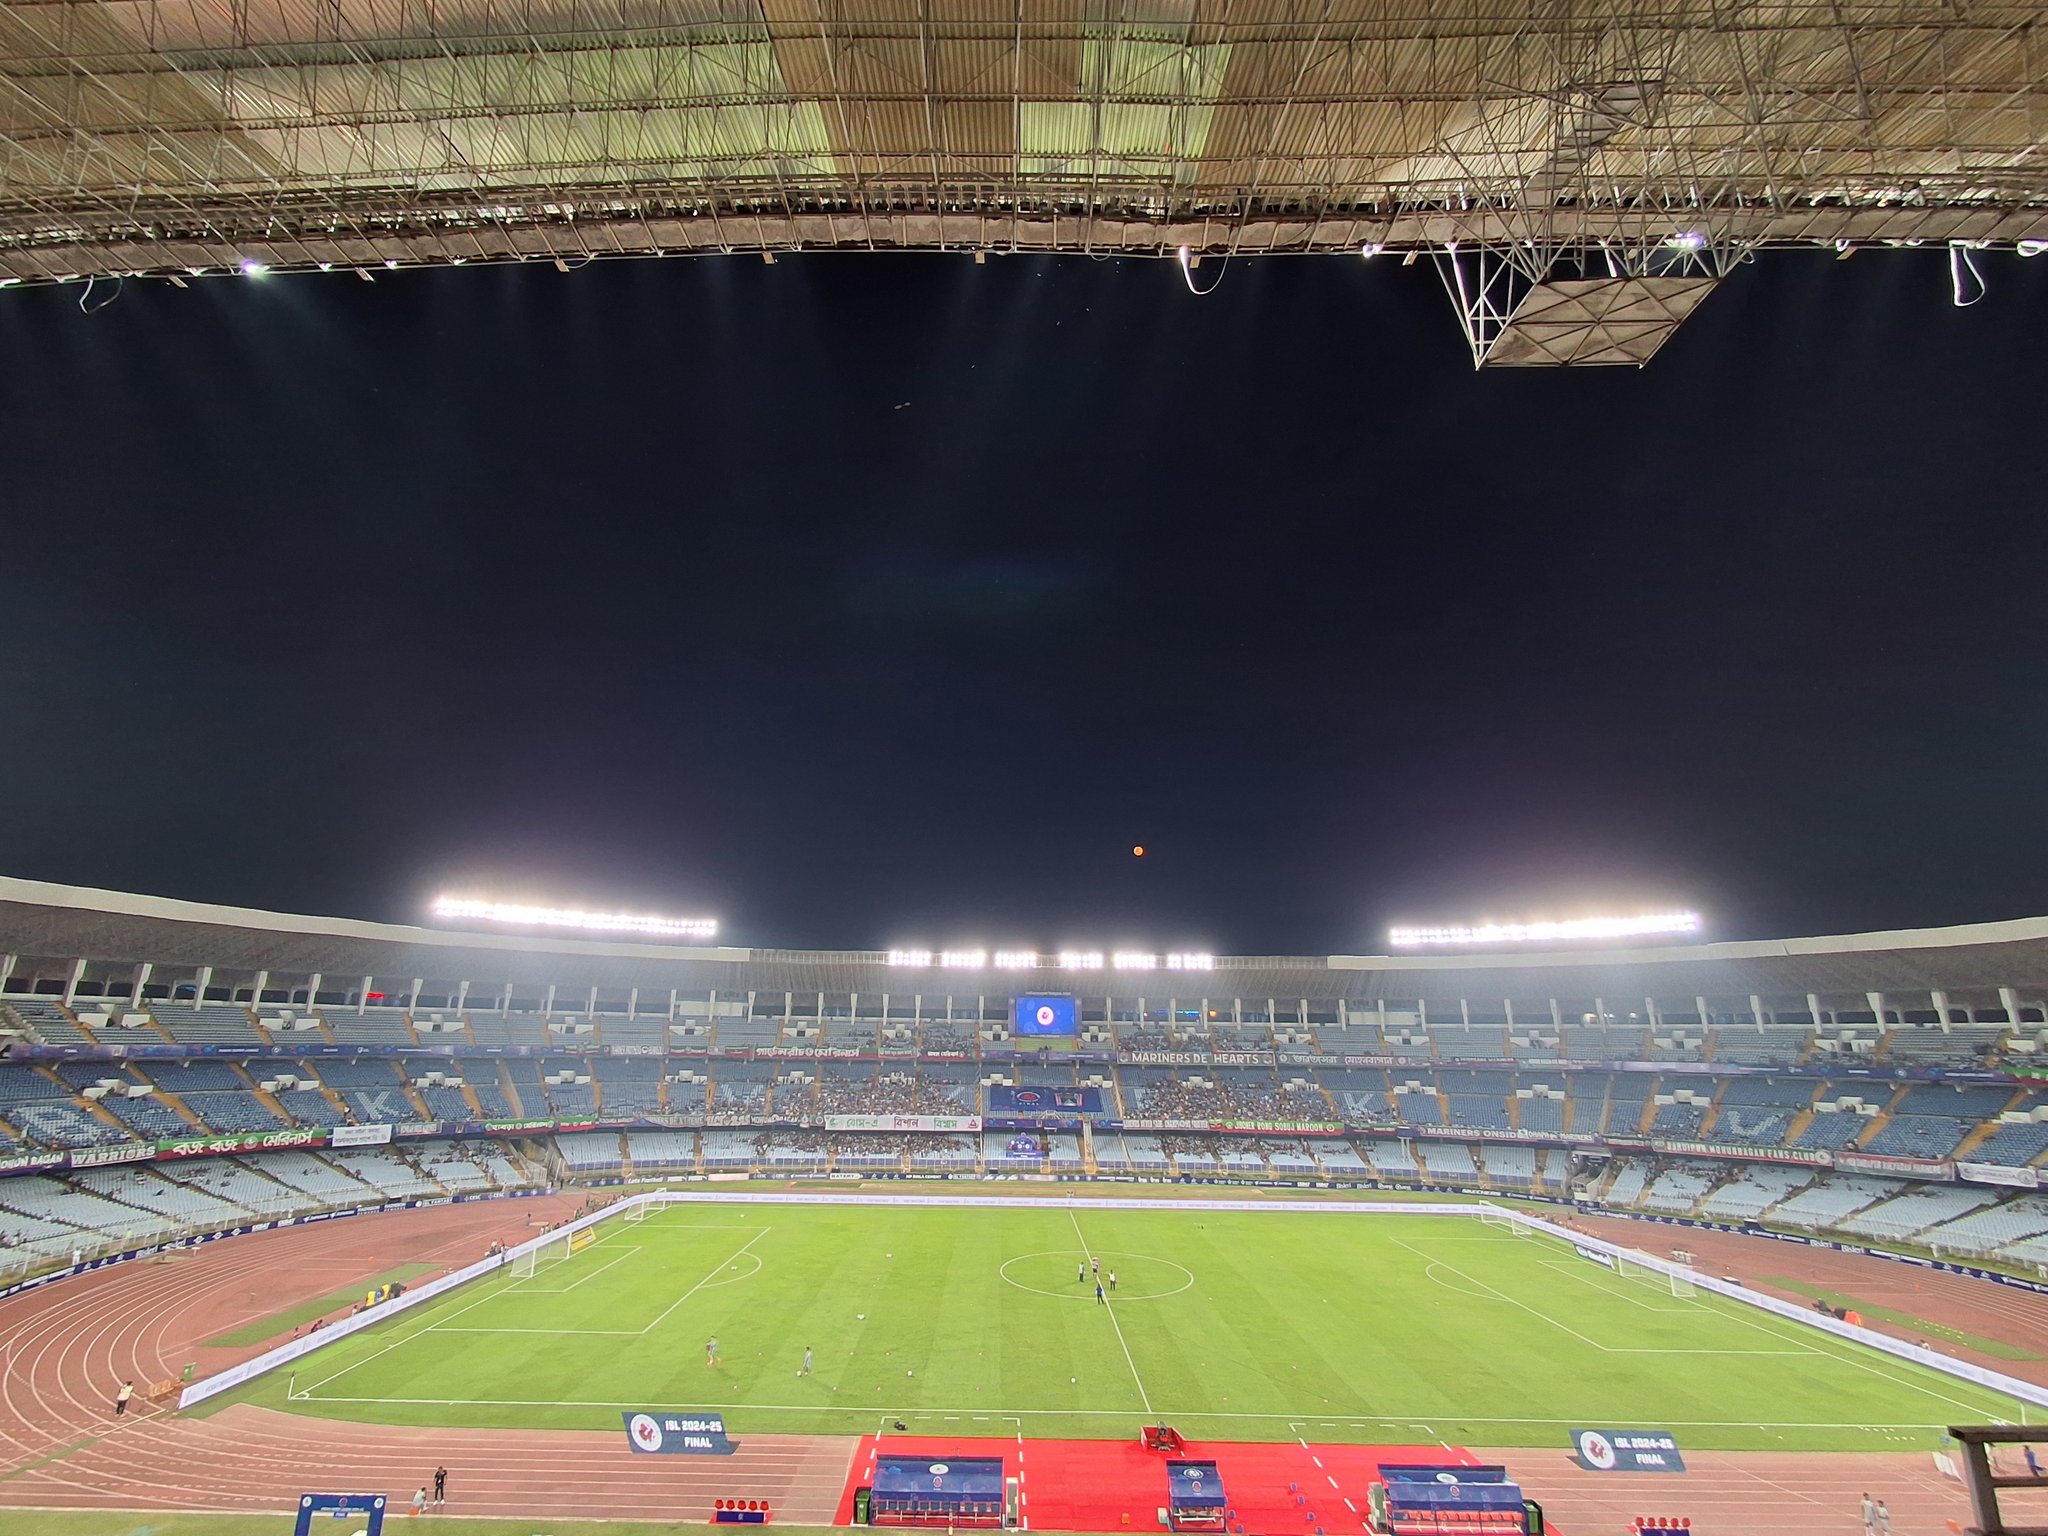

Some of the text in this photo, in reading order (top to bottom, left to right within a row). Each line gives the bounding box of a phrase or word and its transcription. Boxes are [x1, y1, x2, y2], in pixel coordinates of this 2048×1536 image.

[1132, 1052, 1259, 1065] MARINERS DE HEARTS
[1296, 1123, 1324, 1132] MAROON
[1427, 1127, 1481, 1137] MARINERS
[1482, 1129, 1518, 1139] ONSID
[262, 1130, 314, 1148] মেরিনার্স
[30, 1152, 64, 1166] BAGAN
[72, 1146, 156, 1165] WARRIORS
[1792, 1150, 1815, 1162] CLUB
[665, 1420, 723, 1432] ISL 2024-25
[684, 1436, 713, 1448] FINAL
[1614, 1437, 1675, 1449] ISL 2024-25
[1635, 1453, 1665, 1465] FINAL
